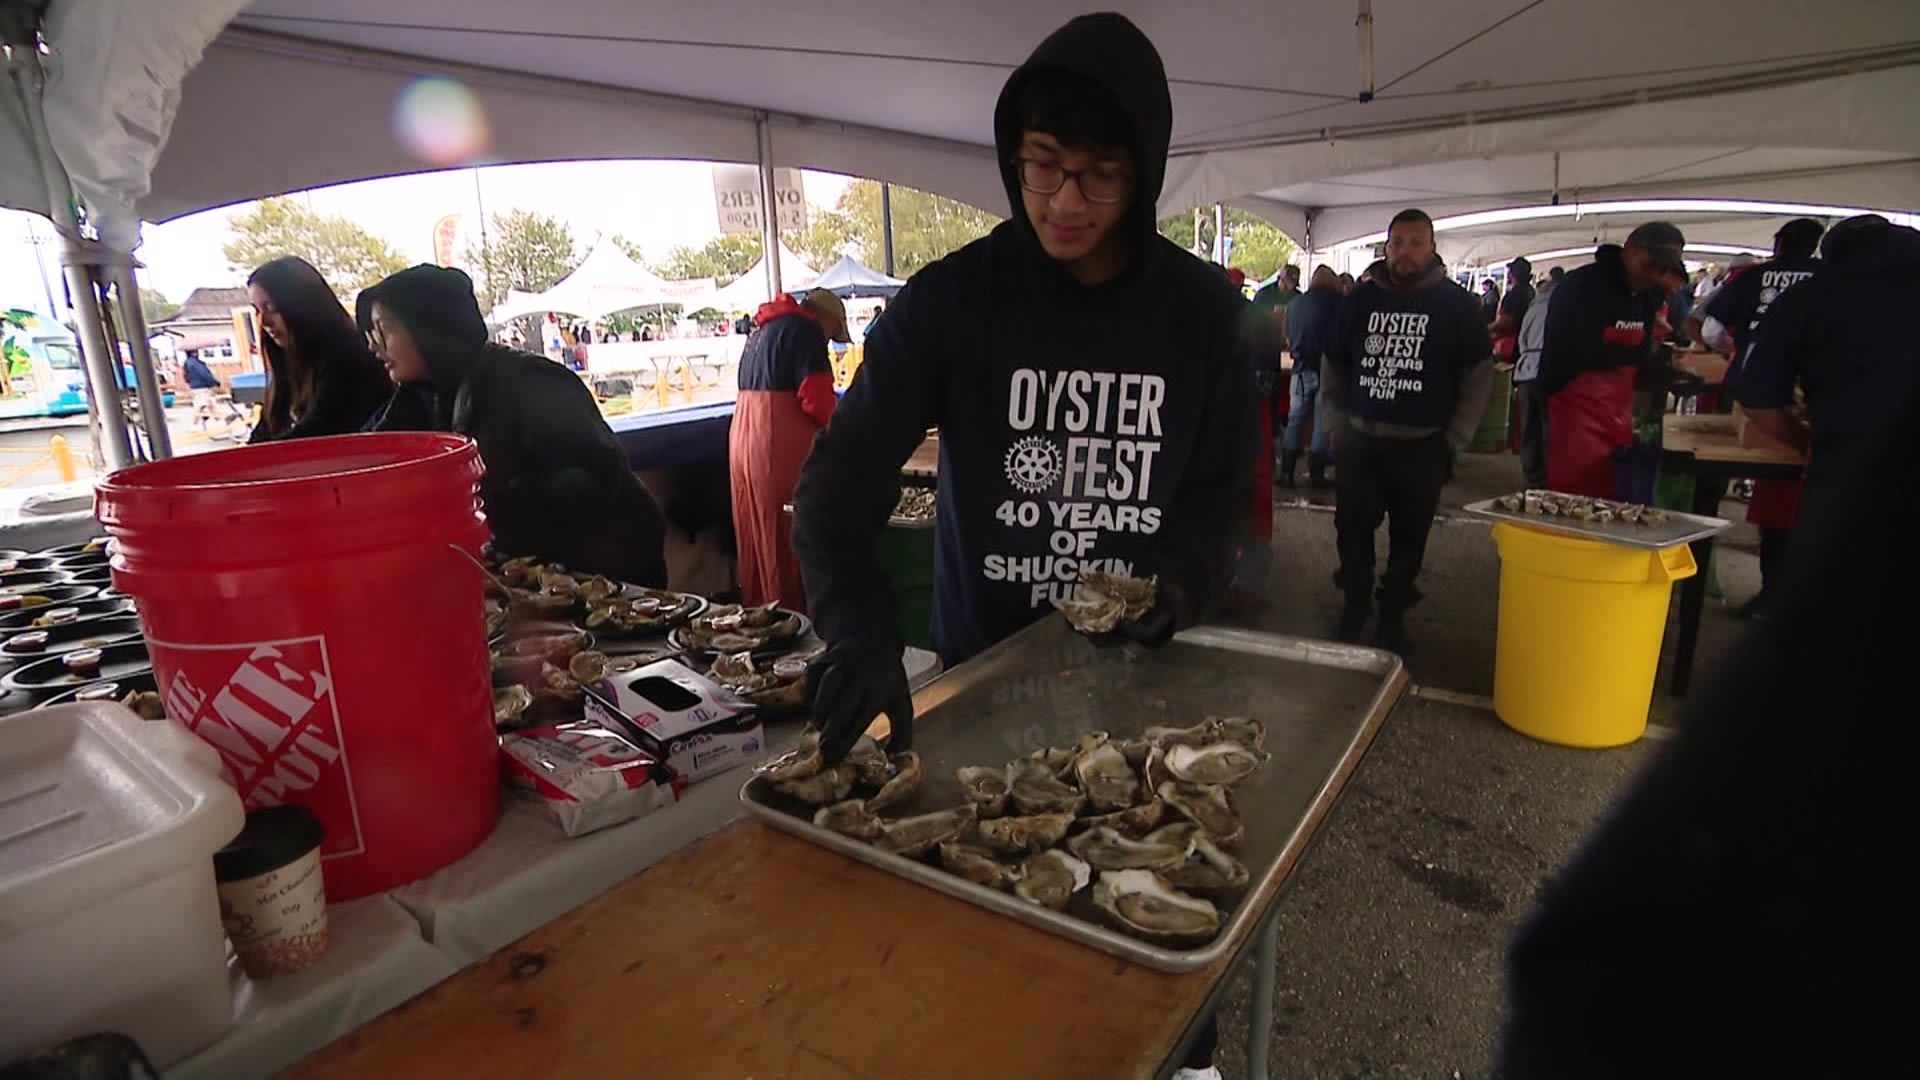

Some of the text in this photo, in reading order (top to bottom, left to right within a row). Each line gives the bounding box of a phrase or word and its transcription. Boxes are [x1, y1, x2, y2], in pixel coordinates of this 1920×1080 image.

[1367, 311, 1429, 336] OYSTER
[1384, 334, 1425, 358] FEST
[1361, 356, 1424, 371] 40 YEARS
[1378, 367, 1398, 378] OF
[1359, 375, 1423, 392] SHUCKING
[1369, 388, 1396, 400] FUN
[1008, 368, 1165, 437] OYSTER
[1062, 436, 1161, 500] FEST
[995, 500, 1162, 534] 40 YEARS
[1050, 530, 1098, 557] OF
[1030, 581, 1082, 609] FU
[194, 645, 330, 786] ME
[245, 724, 342, 807] POT
